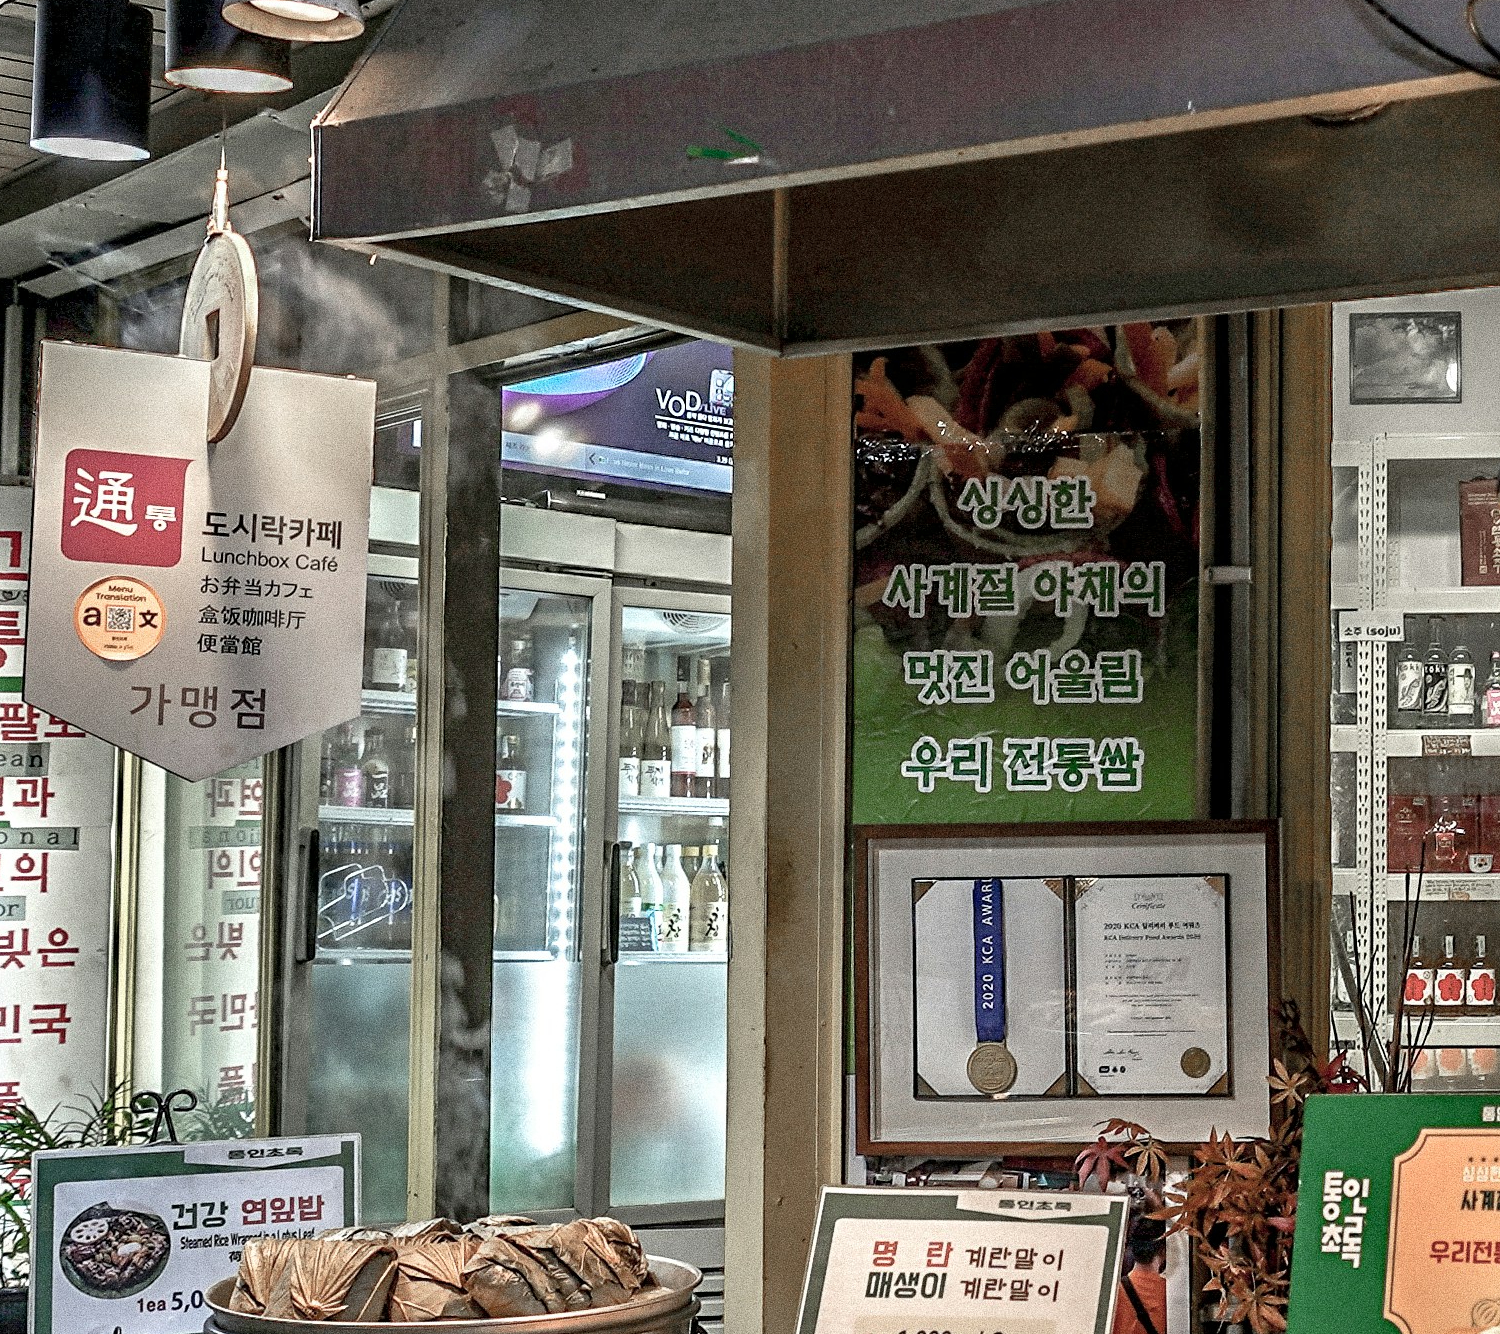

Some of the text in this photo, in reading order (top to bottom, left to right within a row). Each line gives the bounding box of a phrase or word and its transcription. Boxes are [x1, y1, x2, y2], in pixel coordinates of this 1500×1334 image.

[71, 467, 138, 537] 通
[959, 476, 1096, 529] 싱싱한
[145, 504, 177, 532] 통
[202, 511, 343, 549] 도시락카페
[201, 546, 339, 573] Lunchbox Café
[95, 592, 147, 603] Translation
[108, 585, 133, 594] Menu
[200, 574, 314, 600] お弁当カフェ
[883, 561, 1165, 617] 사계절 야채의
[199, 604, 307, 630] 盒饭咖啡厅
[197, 633, 263, 656] 便當館
[1343, 625, 1402, 637] 소주 (soju)
[903, 649, 1143, 705] 멋진 어울림
[130, 683, 268, 730] 가맹점
[902, 736, 1144, 792] 우리 전통쌈
[1123, 922, 1139, 930] KCA
[981, 935, 994, 965] KCA
[982, 973, 994, 1010] 2020
[228, 1146, 304, 1161] 통인초록
[171, 1194, 325, 1231] 건강 연잎밥
[998, 1199, 1072, 1213] 통인초록
[965, 1246, 1064, 1271] 계란말이
[865, 1271, 1060, 1303] 매생이 계란말이
[136, 1297, 167, 1313] 1ea
